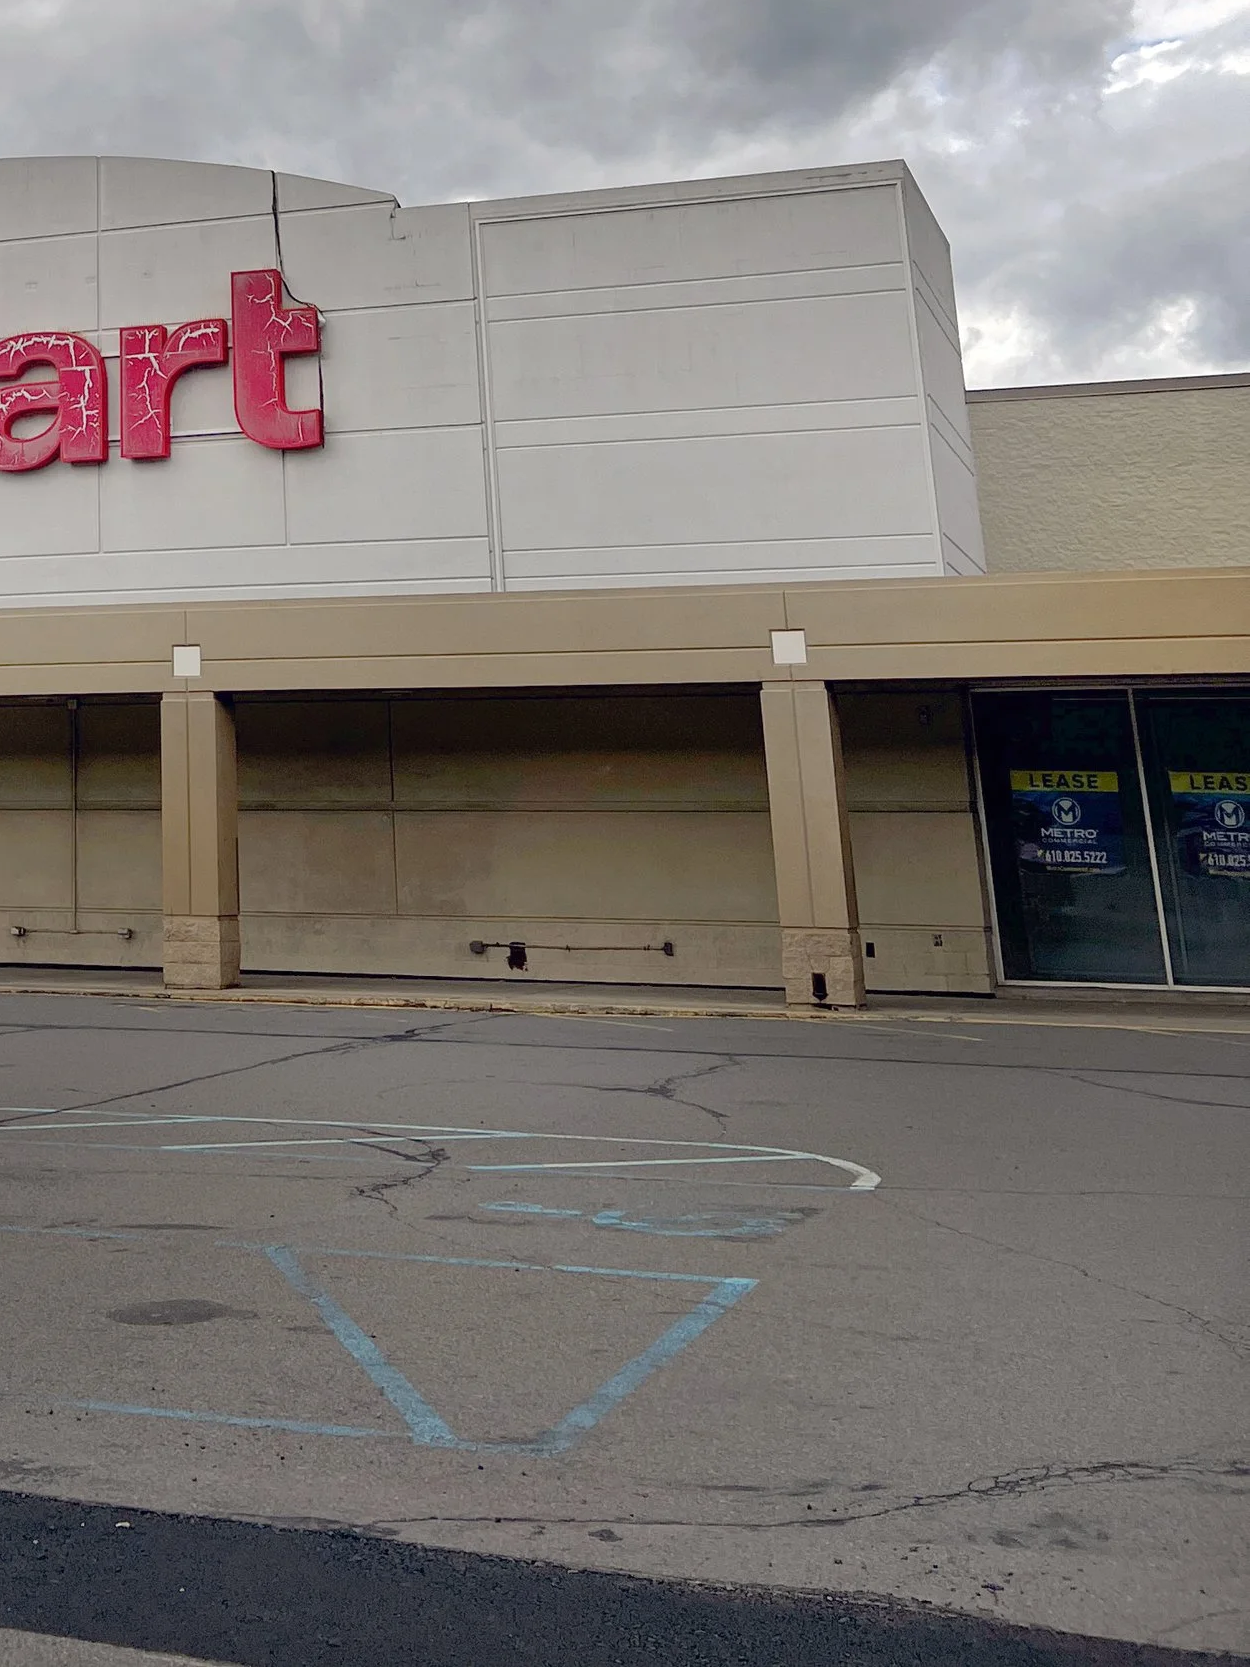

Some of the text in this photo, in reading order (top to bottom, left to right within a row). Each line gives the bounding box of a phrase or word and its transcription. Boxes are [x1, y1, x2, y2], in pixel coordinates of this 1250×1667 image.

[1029, 774, 1099, 789] LEASE
[1190, 775, 1249, 791] LEAS
[1040, 827, 1097, 839] METRO
[1202, 831, 1250, 842] METR
